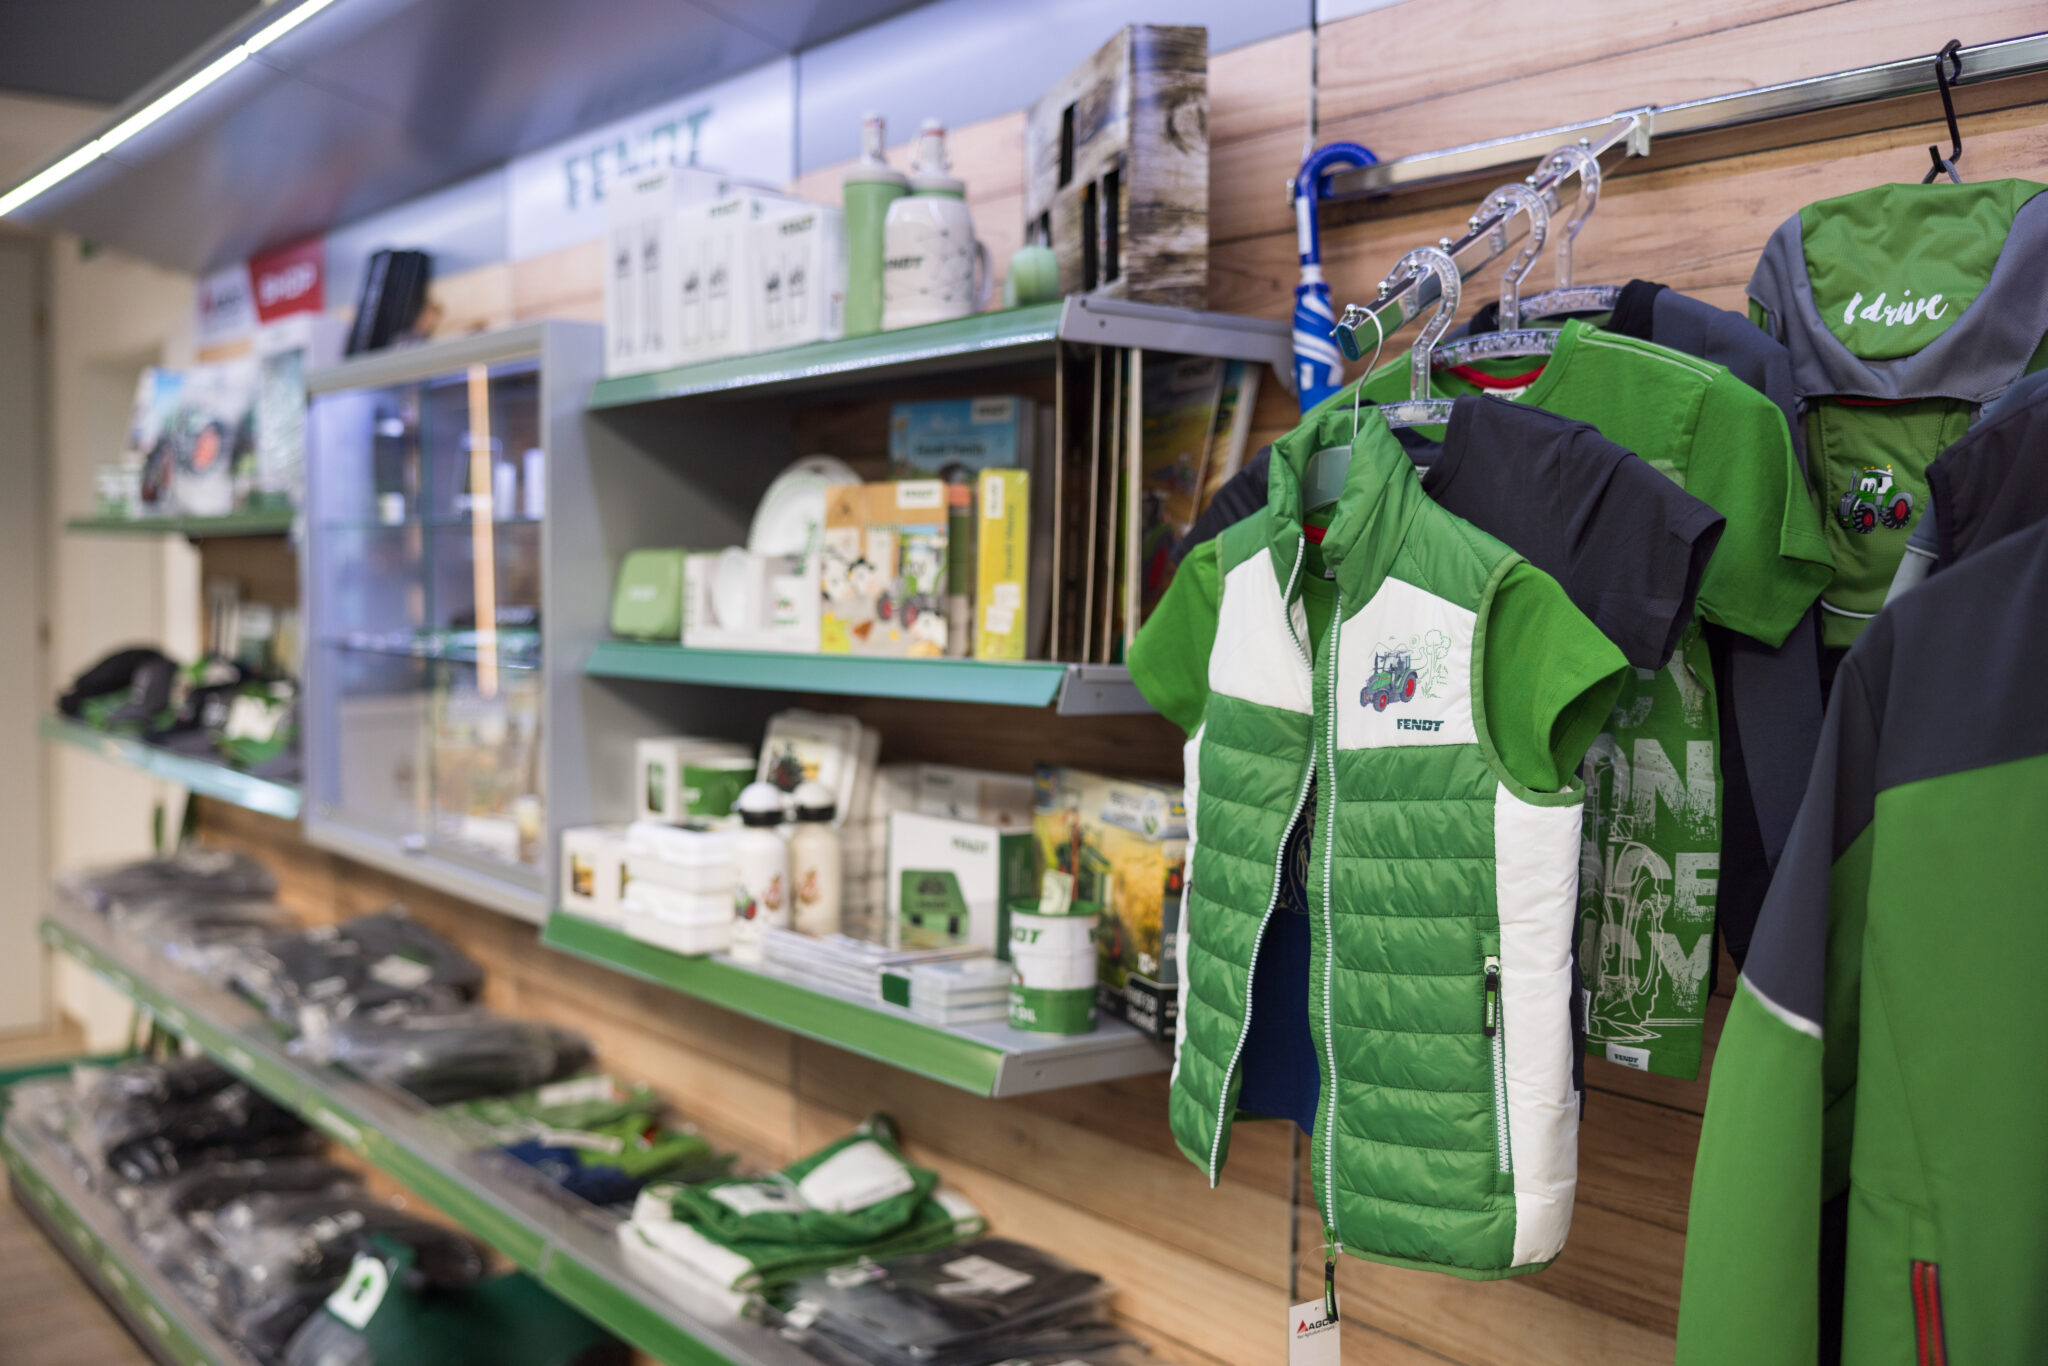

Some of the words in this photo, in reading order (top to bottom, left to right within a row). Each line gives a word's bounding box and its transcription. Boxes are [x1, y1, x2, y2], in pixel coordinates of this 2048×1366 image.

[1843, 291, 1863, 325] I
[1859, 289, 1949, 327] drive
[1396, 718, 1444, 732] FENDT
